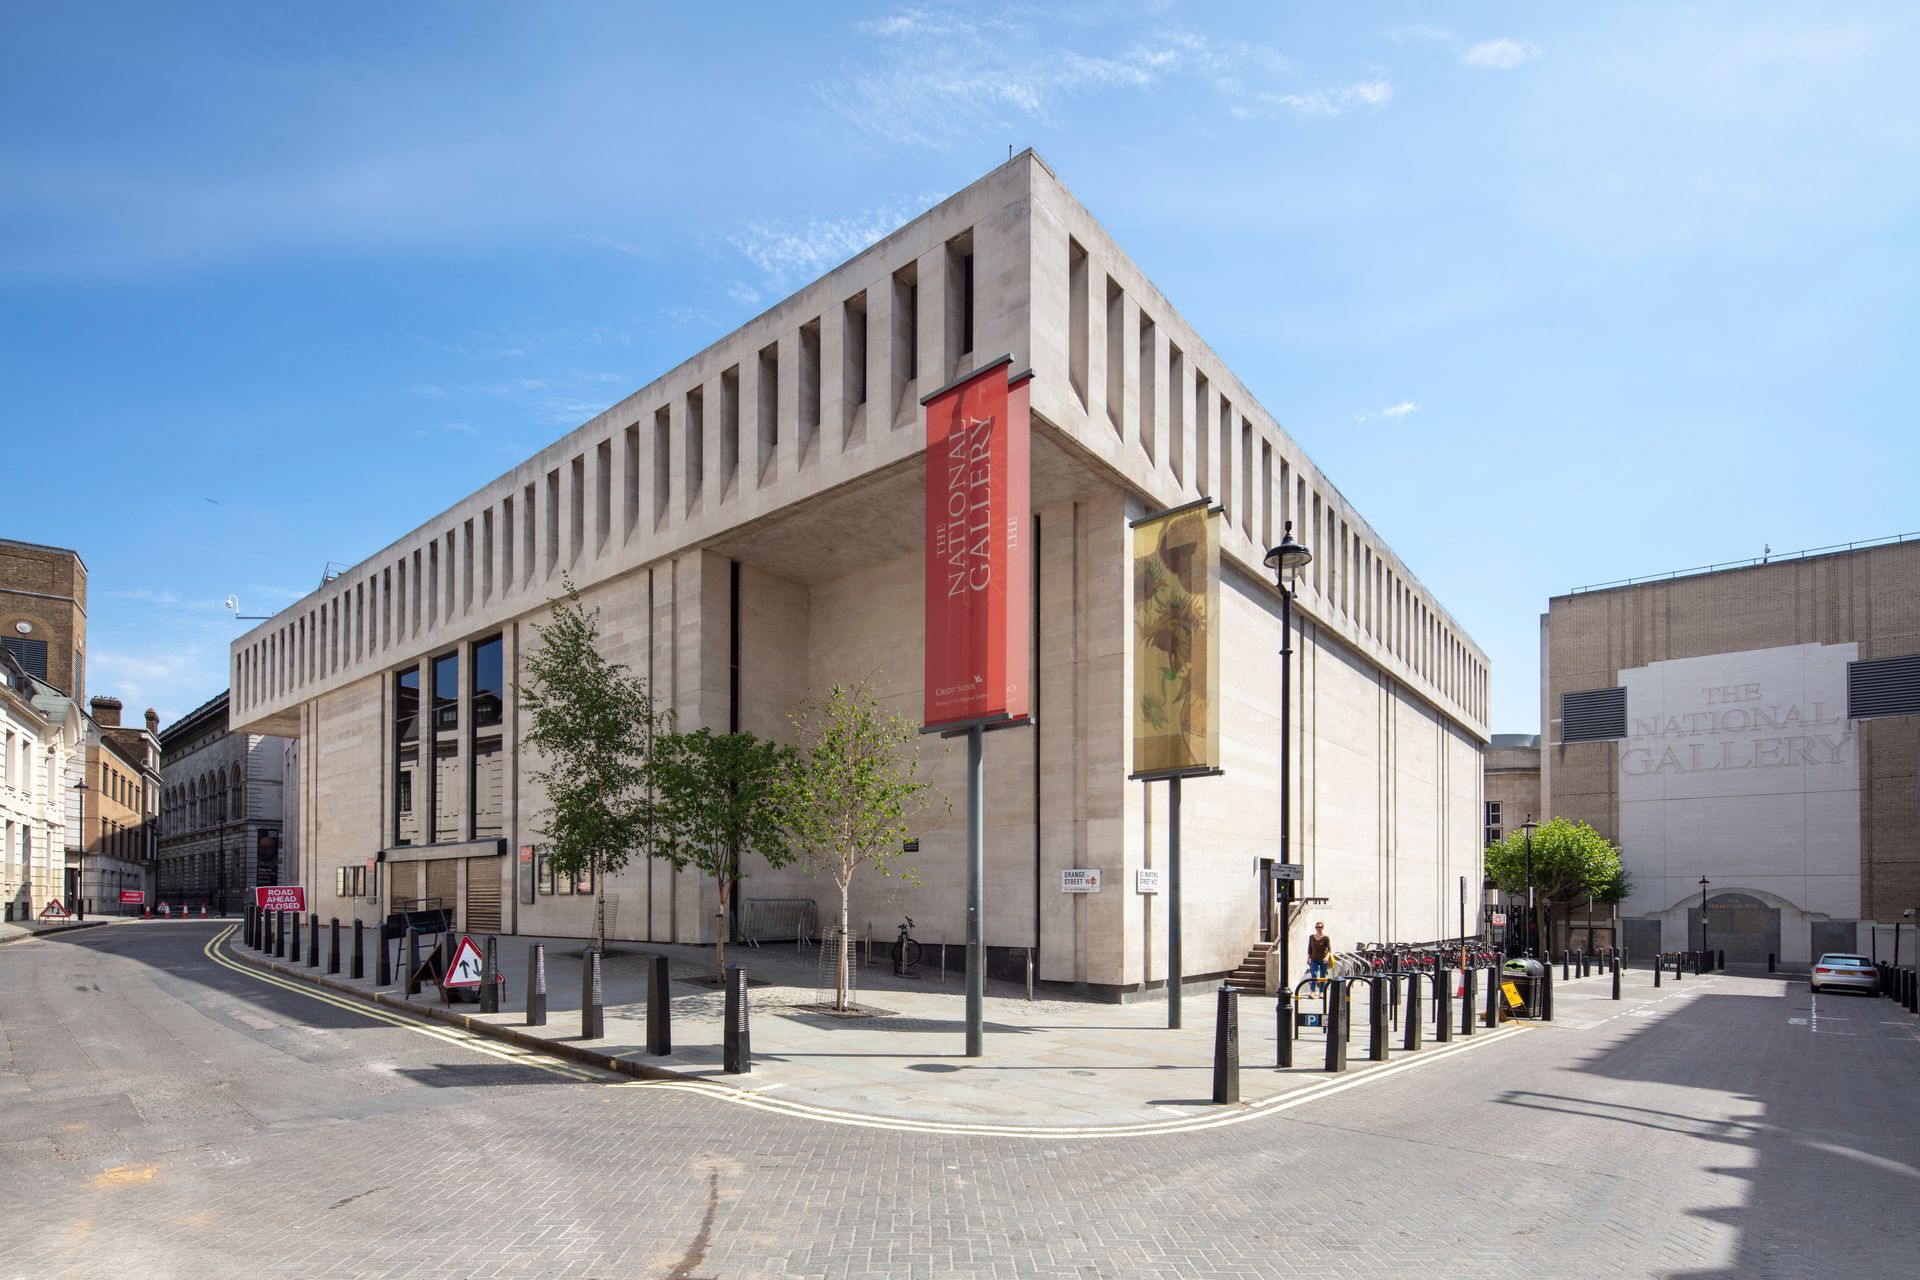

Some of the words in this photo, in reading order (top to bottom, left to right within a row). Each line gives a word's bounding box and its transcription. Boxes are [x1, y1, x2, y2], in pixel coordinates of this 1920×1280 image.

[948, 419, 966, 599] NATIONAL
[969, 415, 991, 592] GALLERY
[936, 522, 946, 558] THE
[1701, 682, 1763, 705] THE
[1633, 701, 1841, 740] NATIONAL
[1621, 731, 1851, 778] GALLERY
[264, 902, 300, 910] CLOSED
[267, 895, 297, 903] AHEAD
[1307, 1014, 1317, 1026] P
